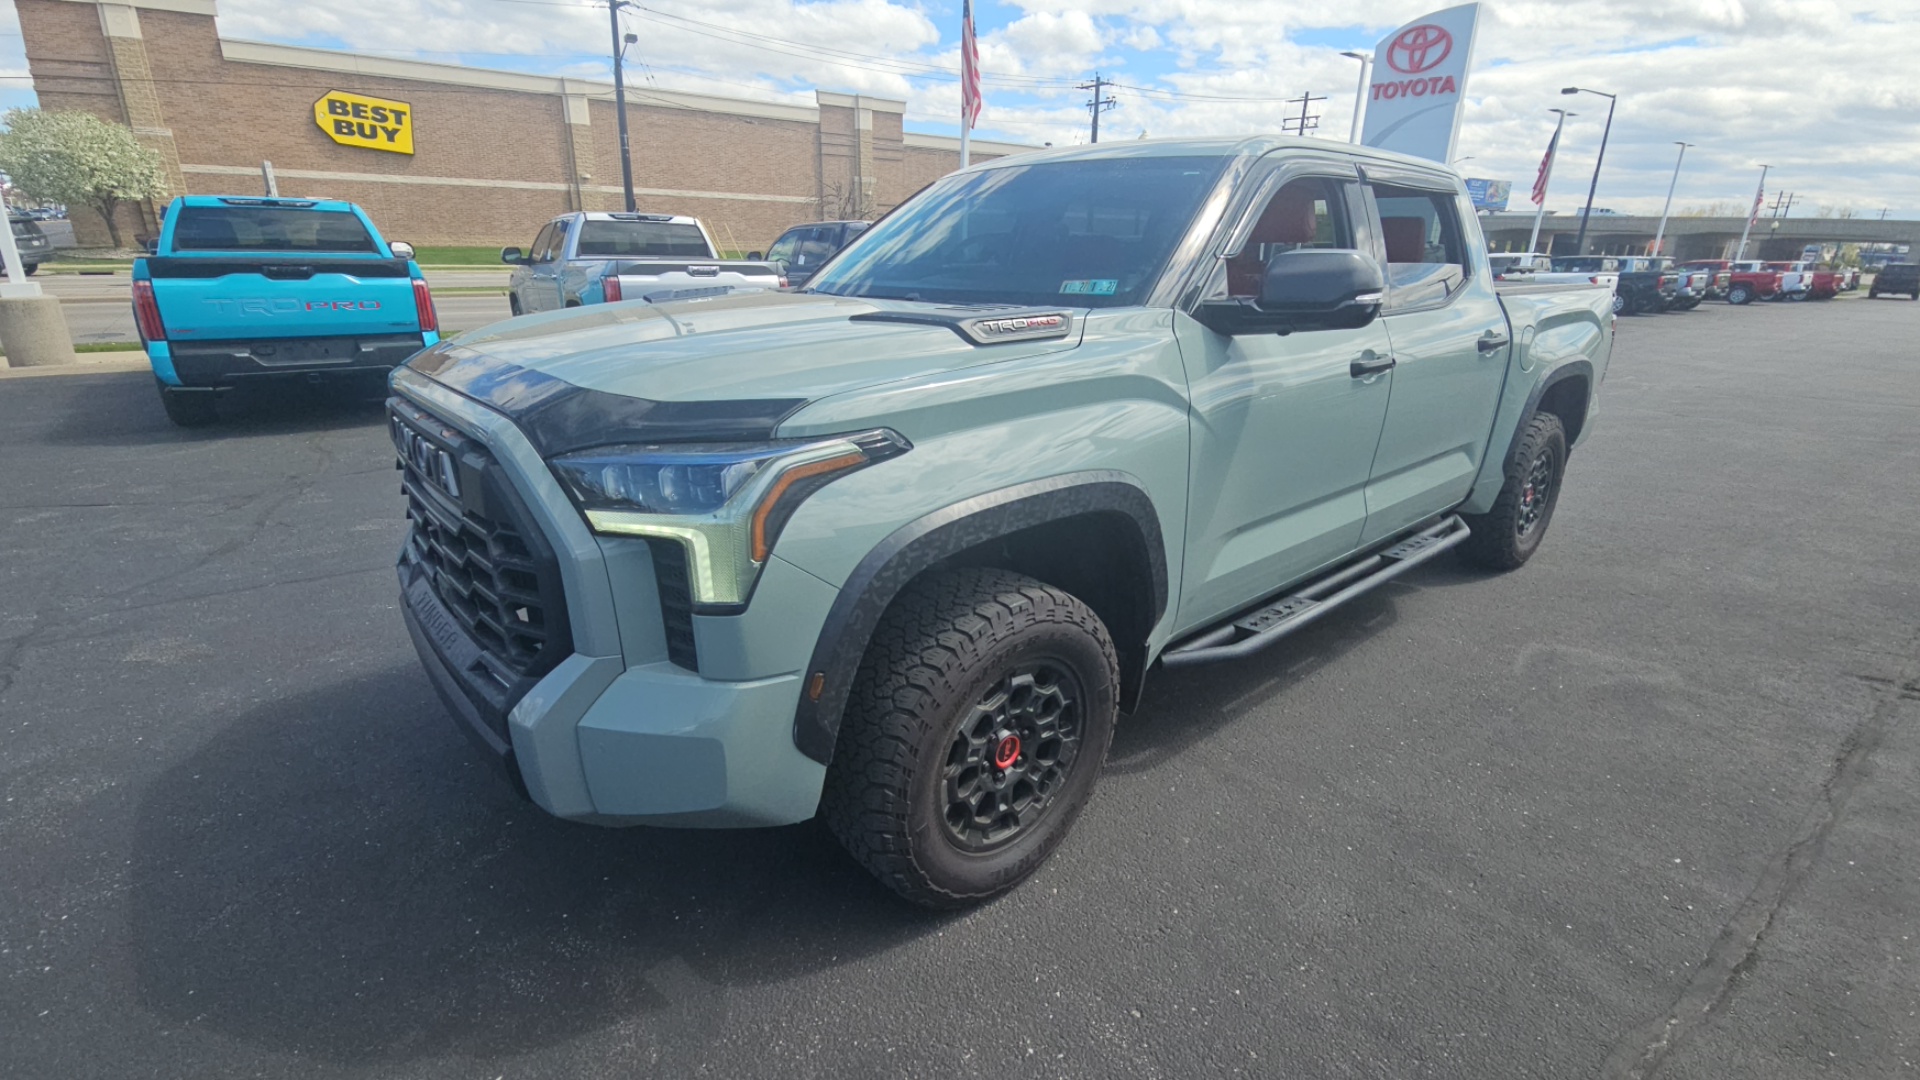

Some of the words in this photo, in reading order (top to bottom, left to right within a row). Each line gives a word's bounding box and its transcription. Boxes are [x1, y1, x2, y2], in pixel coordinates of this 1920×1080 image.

[1372, 75, 1456, 100] TOYOTA
[327, 98, 407, 126] BEST
[333, 119, 401, 143] BUY
[202, 297, 301, 317] TRD
[305, 300, 382, 312] PRO
[983, 318, 1027, 333] TRD
[1026, 316, 1058, 327] PRO
